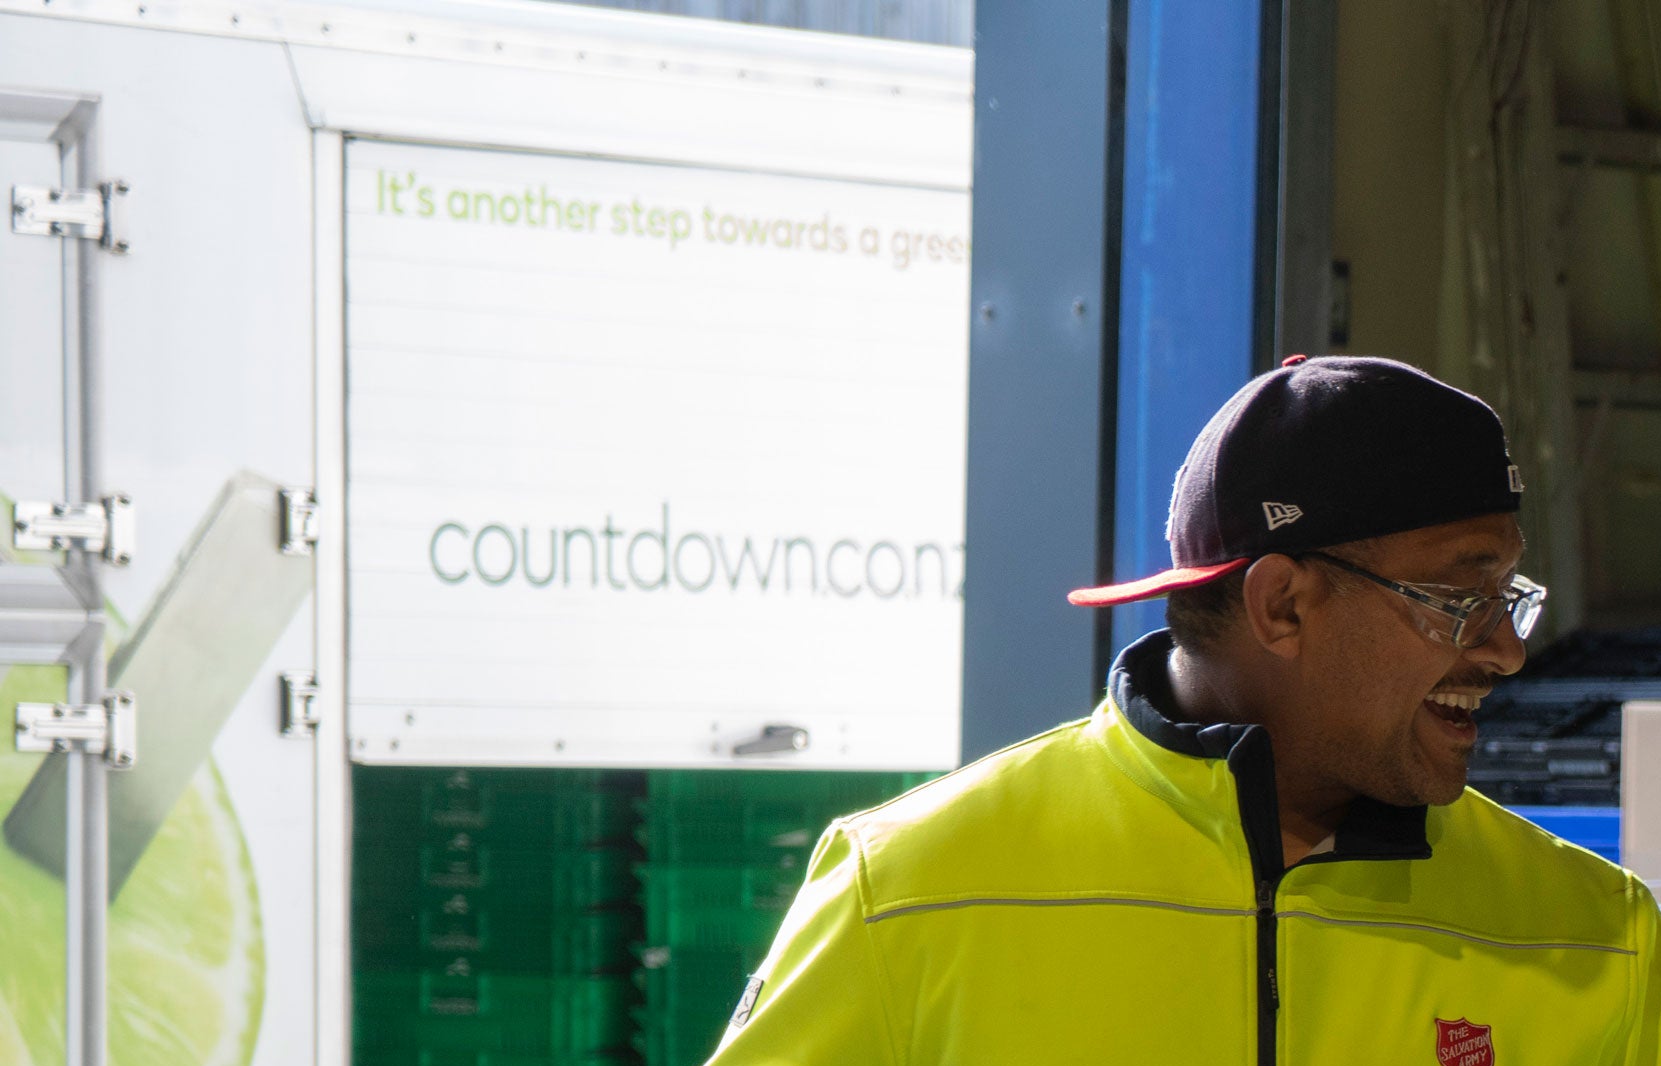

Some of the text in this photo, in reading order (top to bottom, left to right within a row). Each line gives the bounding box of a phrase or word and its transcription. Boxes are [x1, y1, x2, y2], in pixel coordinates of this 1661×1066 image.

[375, 167, 971, 272] It's another step towards a gree
[1441, 1032, 1491, 1062] SALVATION
[1448, 1026, 1470, 1043] THE
